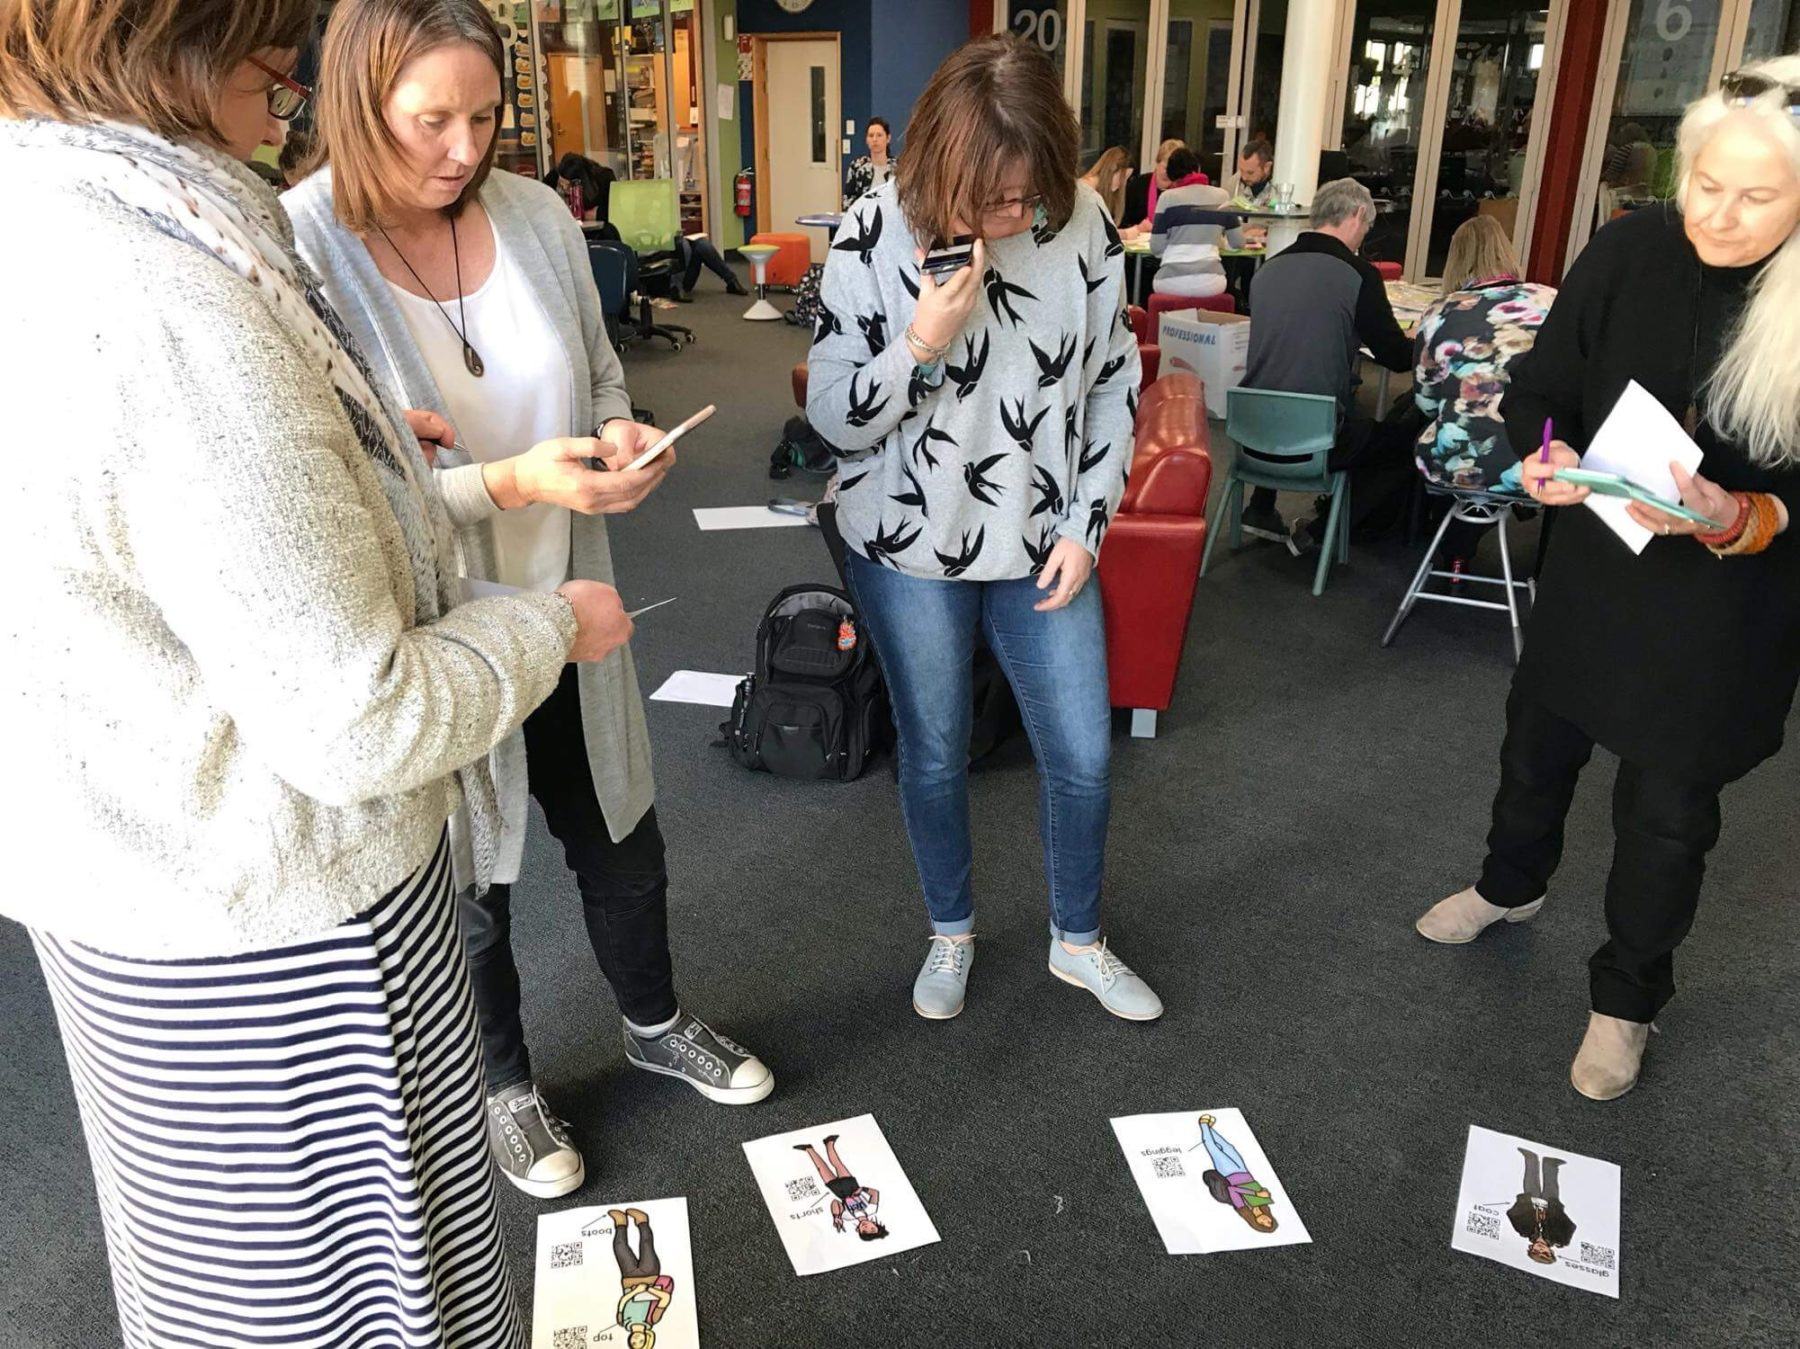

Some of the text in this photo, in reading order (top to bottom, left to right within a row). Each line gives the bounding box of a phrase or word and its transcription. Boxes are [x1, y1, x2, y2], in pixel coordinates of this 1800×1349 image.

[1656, 0, 1692, 41] 6
[1014, 8, 1061, 51] 20
[1162, 325, 1216, 345] PROFESSIONAL
[1140, 1147, 1183, 1157] leggings
[790, 1206, 824, 1220] shorts
[1473, 1204, 1500, 1216] coat
[581, 1227, 613, 1238] boots
[1564, 1261, 1611, 1278] glasses
[592, 1332, 613, 1343] top
